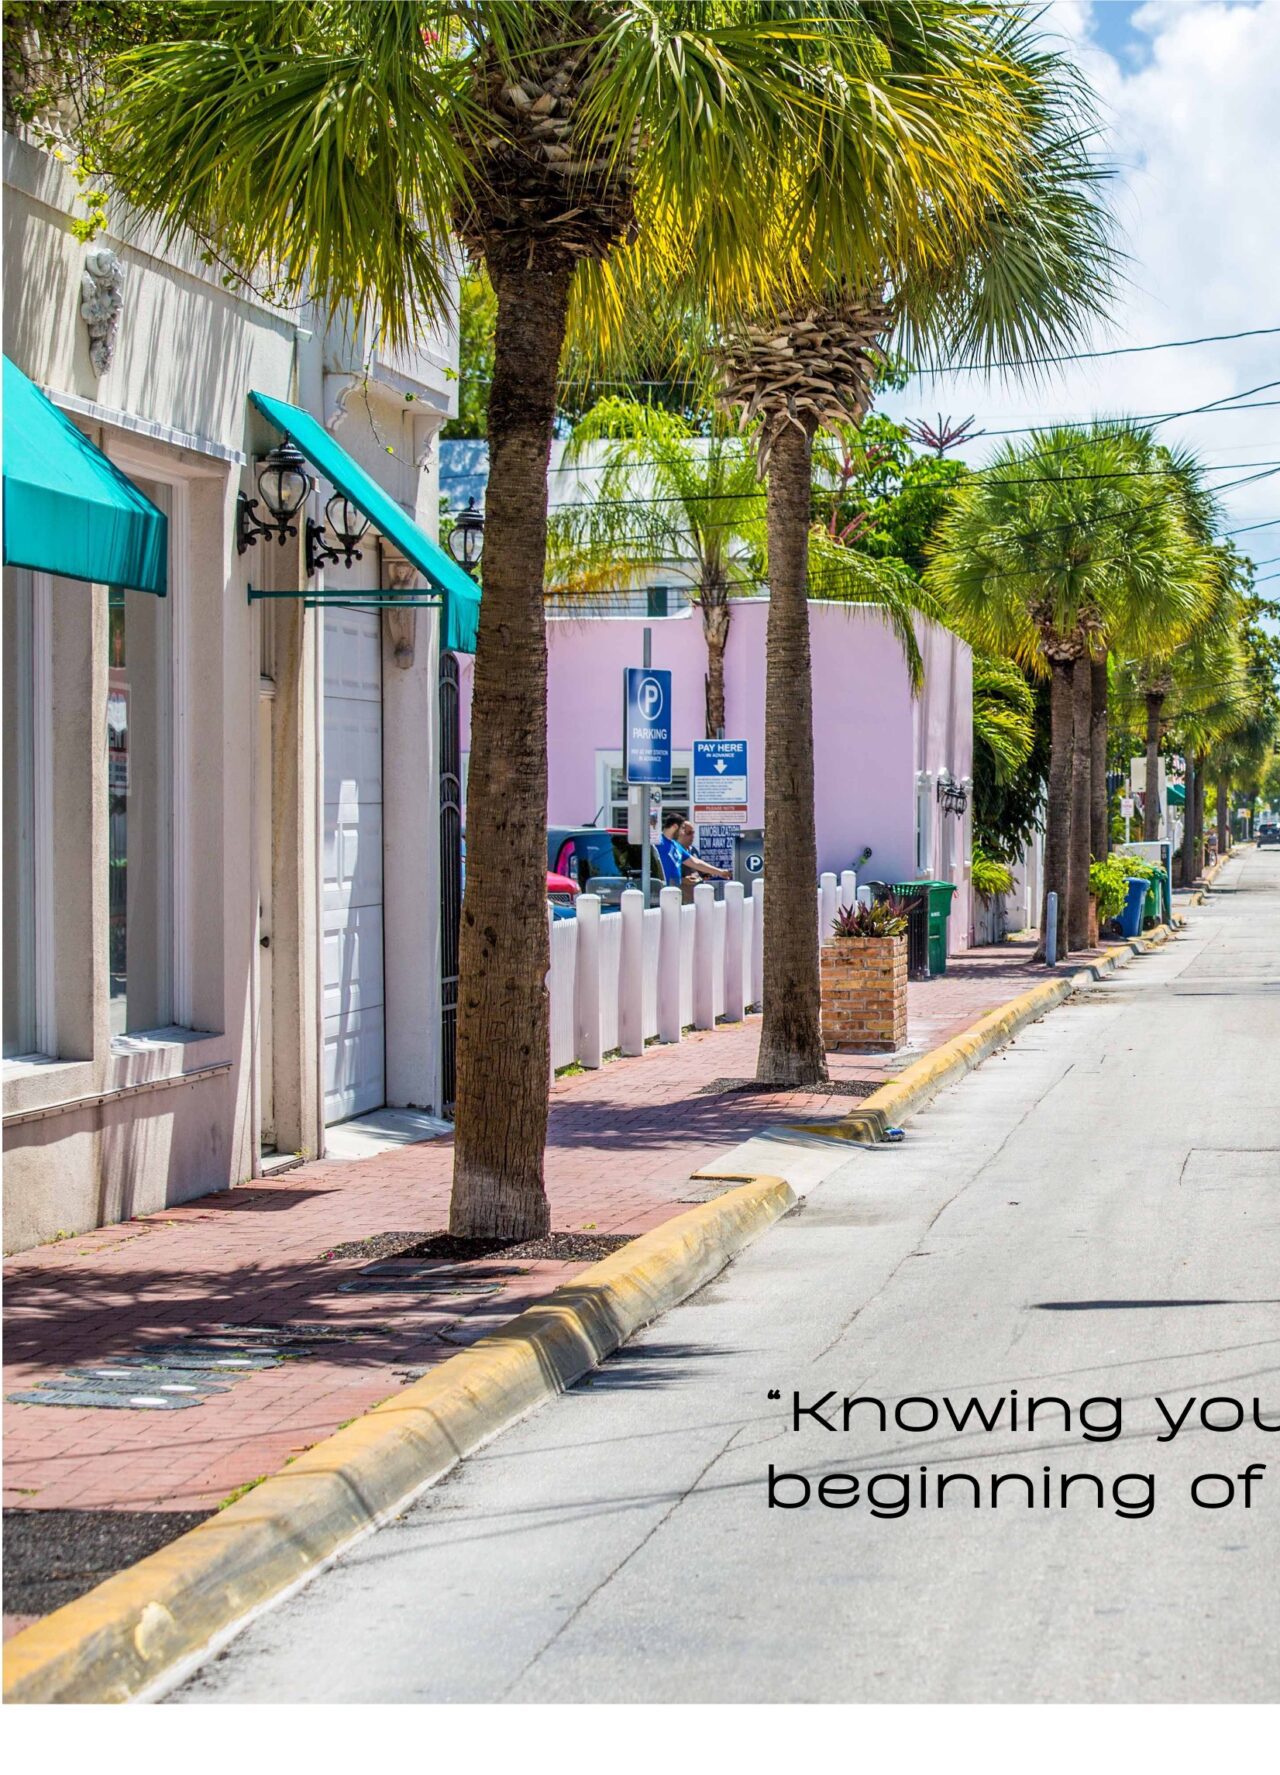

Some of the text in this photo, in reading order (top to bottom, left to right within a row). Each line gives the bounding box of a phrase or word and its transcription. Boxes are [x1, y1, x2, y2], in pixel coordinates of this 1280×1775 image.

[645, 685, 658, 712] P
[632, 727, 668, 740] PARKING
[697, 743, 743, 752] PAY HERE
[700, 837, 711, 848] TOW
[712, 837, 726, 848] AWAY
[750, 856, 761, 870] P
